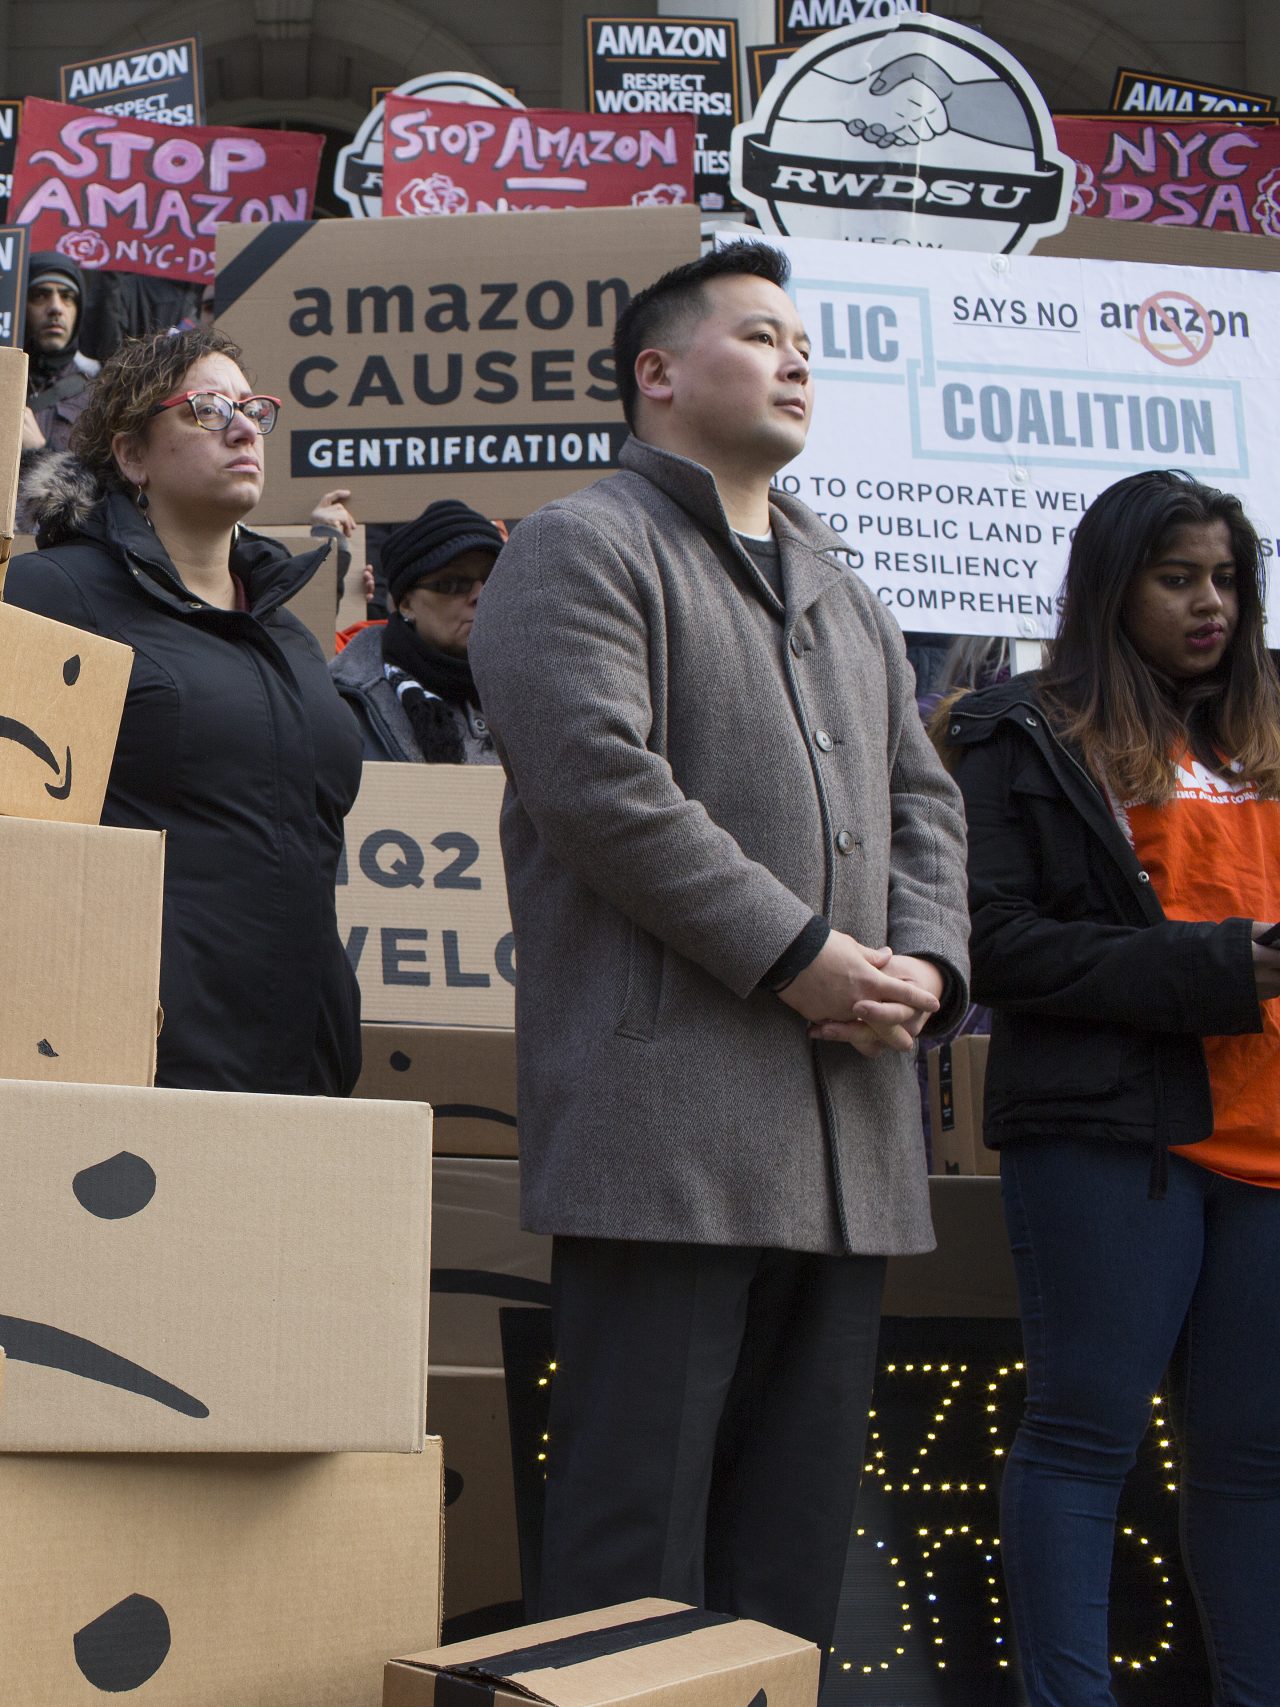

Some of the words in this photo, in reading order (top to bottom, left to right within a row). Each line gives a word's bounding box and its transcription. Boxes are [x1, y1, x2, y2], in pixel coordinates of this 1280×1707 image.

[597, 25, 727, 58] AMAZON
[69, 46, 189, 99] AMAZON
[622, 73, 706, 91] RESPECT
[596, 90, 732, 116] WORKERS!
[1123, 82, 1260, 112] AMAZ
[29, 115, 267, 192] STOP
[390, 108, 495, 163] STOP
[495, 117, 678, 170] AMAZON
[1102, 127, 1260, 177] NYC
[771, 166, 1031, 209] RWDSU
[1100, 184, 1252, 232] DSA
[288, 277, 631, 337] amazon
[953, 296, 1028, 325] SAYS
[1038, 302, 1079, 328] NO
[1100, 302, 1250, 338] amazon
[820, 302, 899, 363] LIC
[288, 349, 621, 409] CAUSES
[942, 382, 1216, 456] COALITION
[307, 432, 611, 469] GENTRIFICATION
[810, 477, 846, 497] TO
[856, 479, 1028, 509] CORPORATE
[1035, 489, 1102, 512] WEL
[817, 512, 848, 533] O
[859, 515, 958, 539] PUBLIC
[969, 521, 1042, 544] LAND
[874, 552, 1038, 579] RESILIENCY
